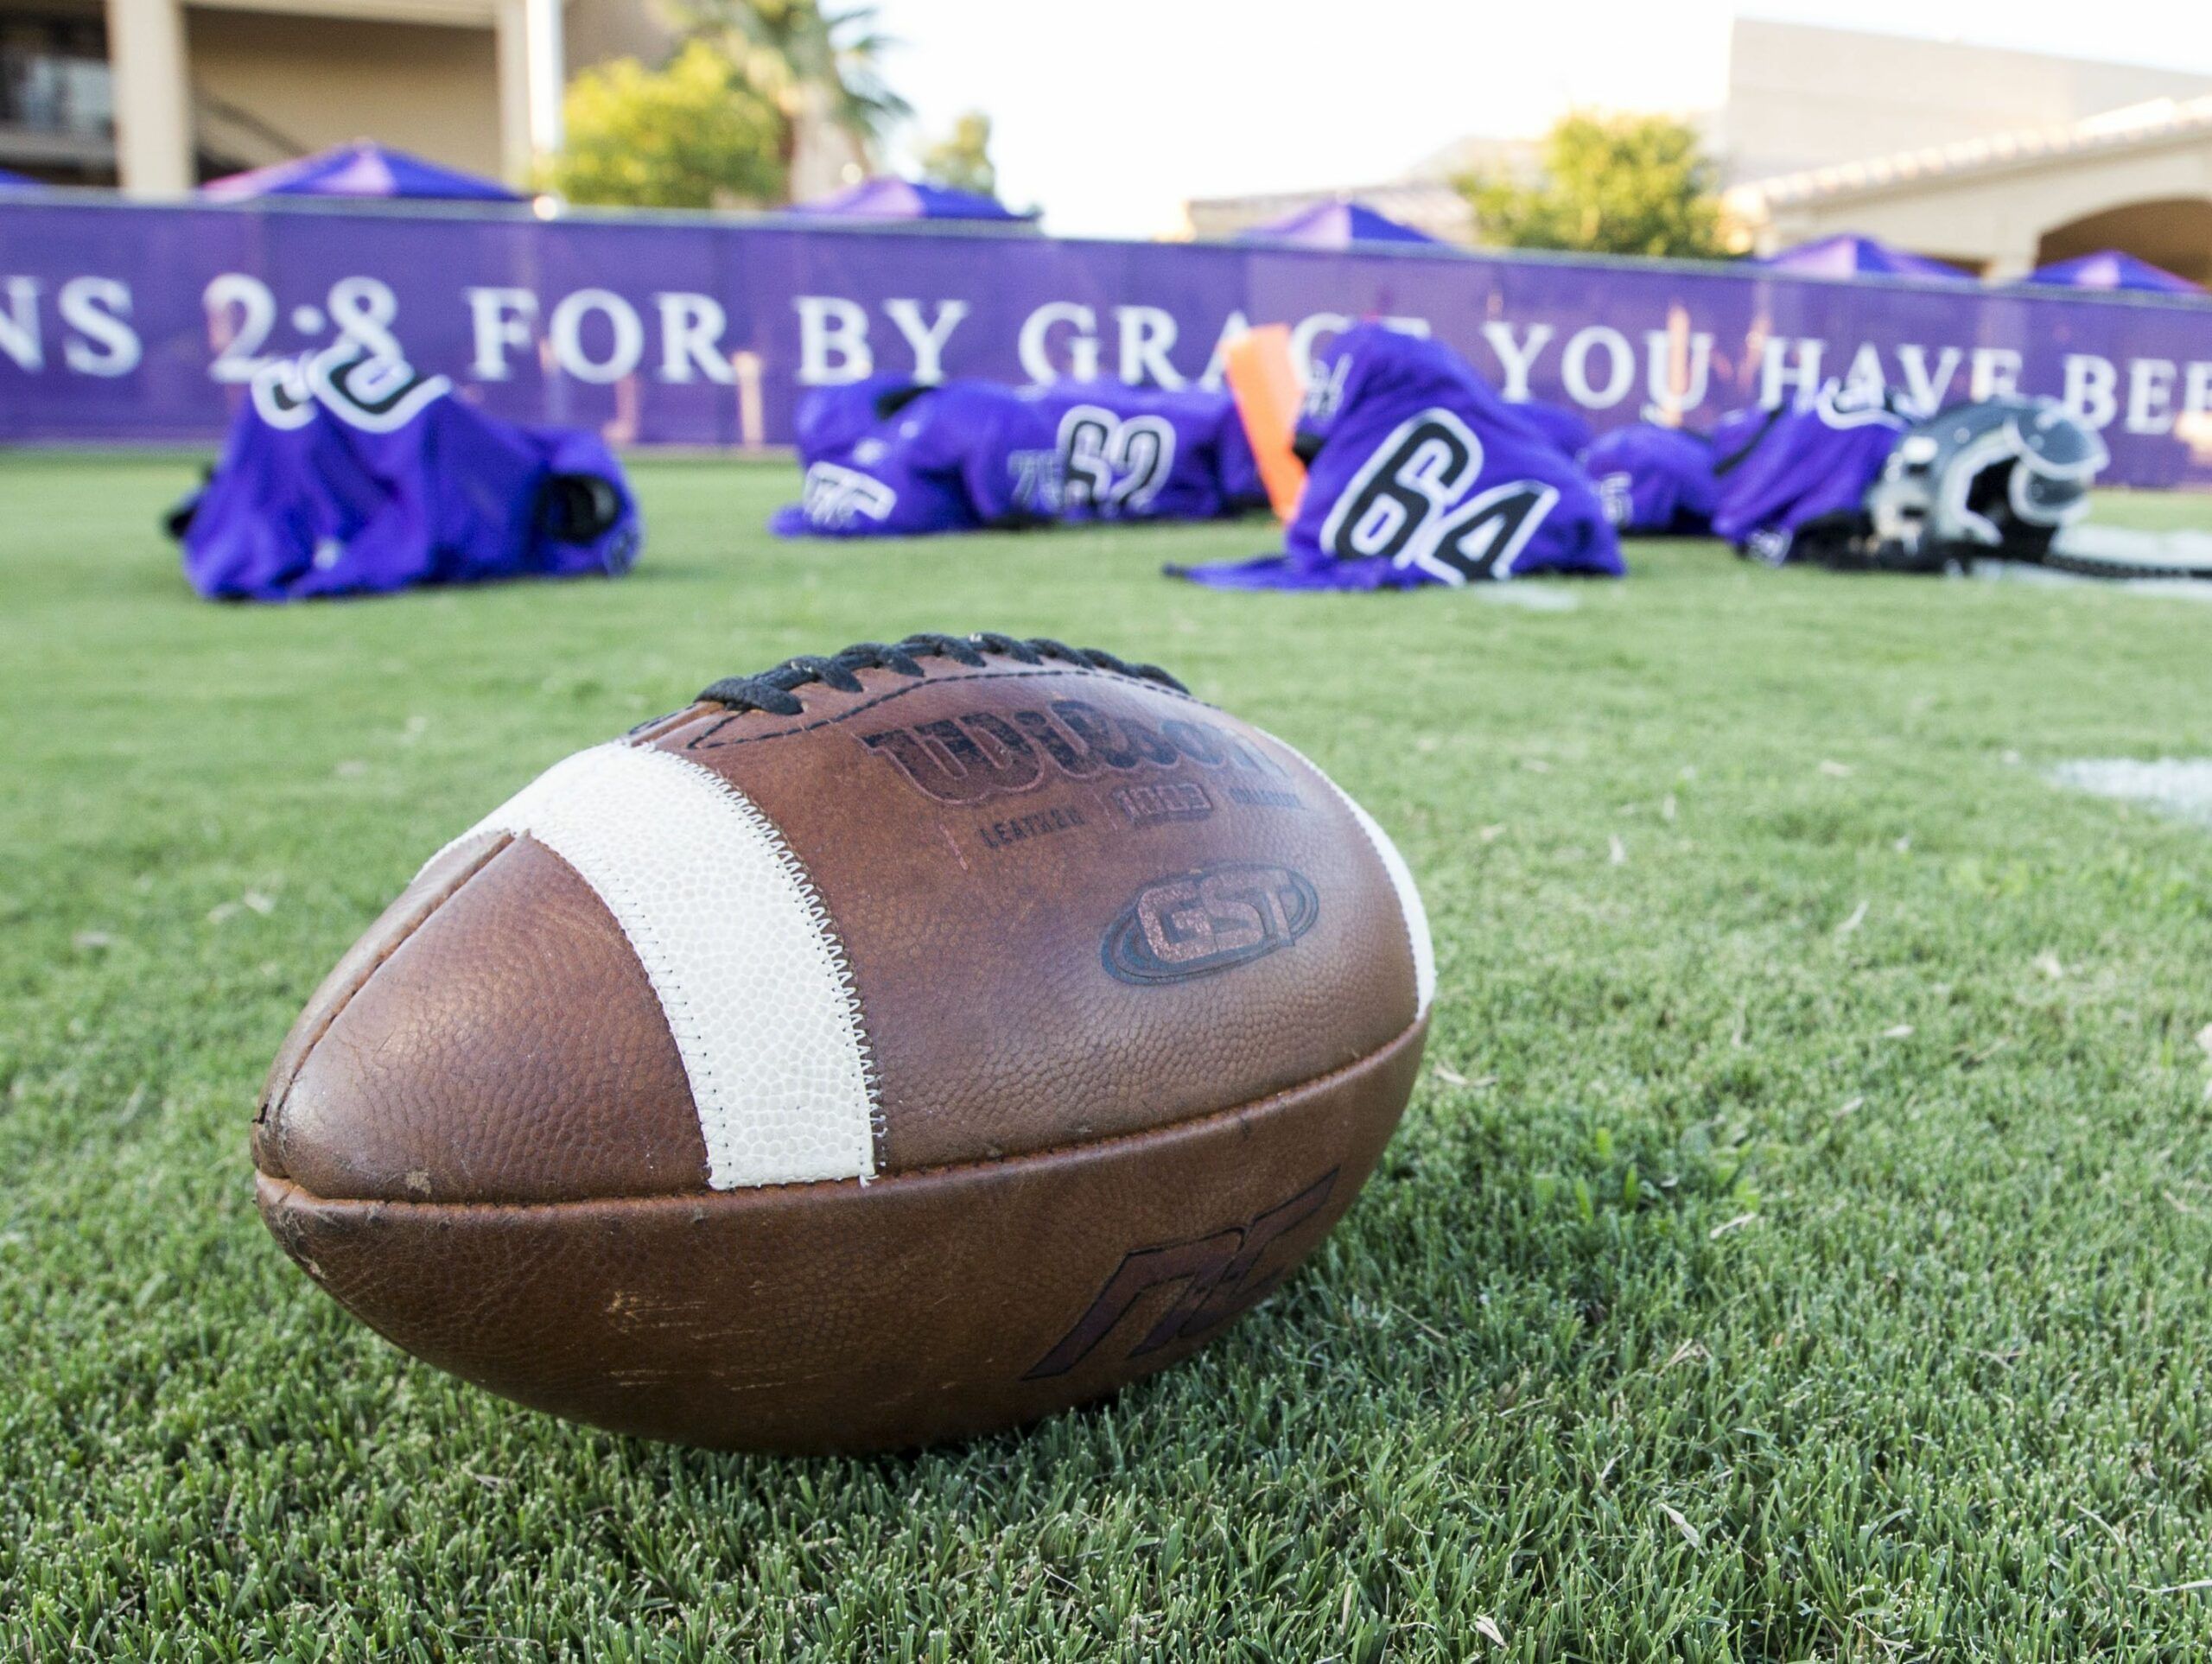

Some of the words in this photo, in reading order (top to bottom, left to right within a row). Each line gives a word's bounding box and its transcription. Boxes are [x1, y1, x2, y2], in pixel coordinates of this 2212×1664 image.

[464, 286, 740, 385] FOR
[792, 295, 969, 385] BY
[1482, 321, 1714, 413] YOU
[1759, 337, 2024, 419] HAVE
[1319, 406, 1560, 587] 64
[1136, 867, 1295, 963] GST
